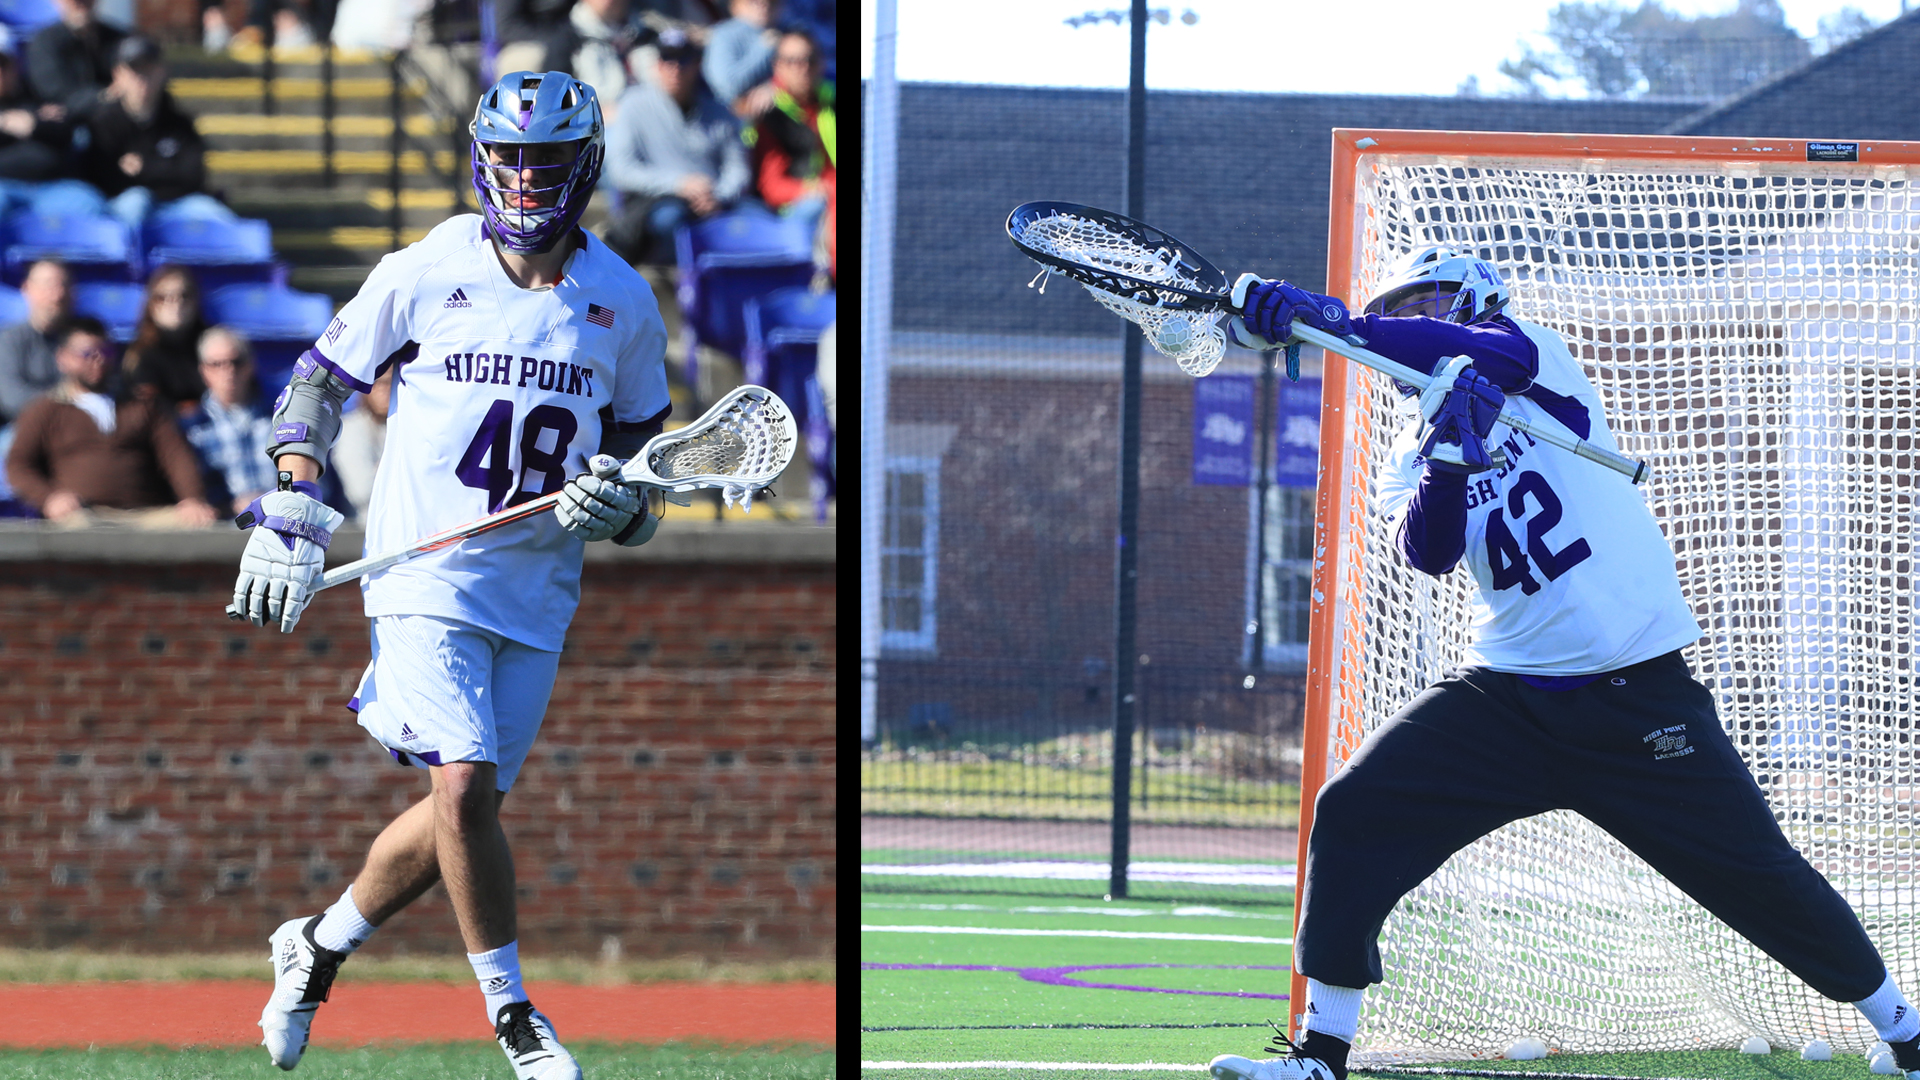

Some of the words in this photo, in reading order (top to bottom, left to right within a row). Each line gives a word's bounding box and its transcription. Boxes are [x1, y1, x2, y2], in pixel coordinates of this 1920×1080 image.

[443, 301, 472, 309] adidas
[445, 353, 514, 386] HIGH
[518, 356, 594, 397] POINT
[455, 399, 578, 515] 48
[597, 458, 610, 467] 48
[1466, 478, 1498, 510] GH
[1485, 470, 1592, 596] 42
[1643, 729, 1662, 743] HIGH
[1663, 723, 1686, 734] POINT
[1653, 735, 1687, 753] HPU
[1654, 745, 1695, 760] LACROSSE
